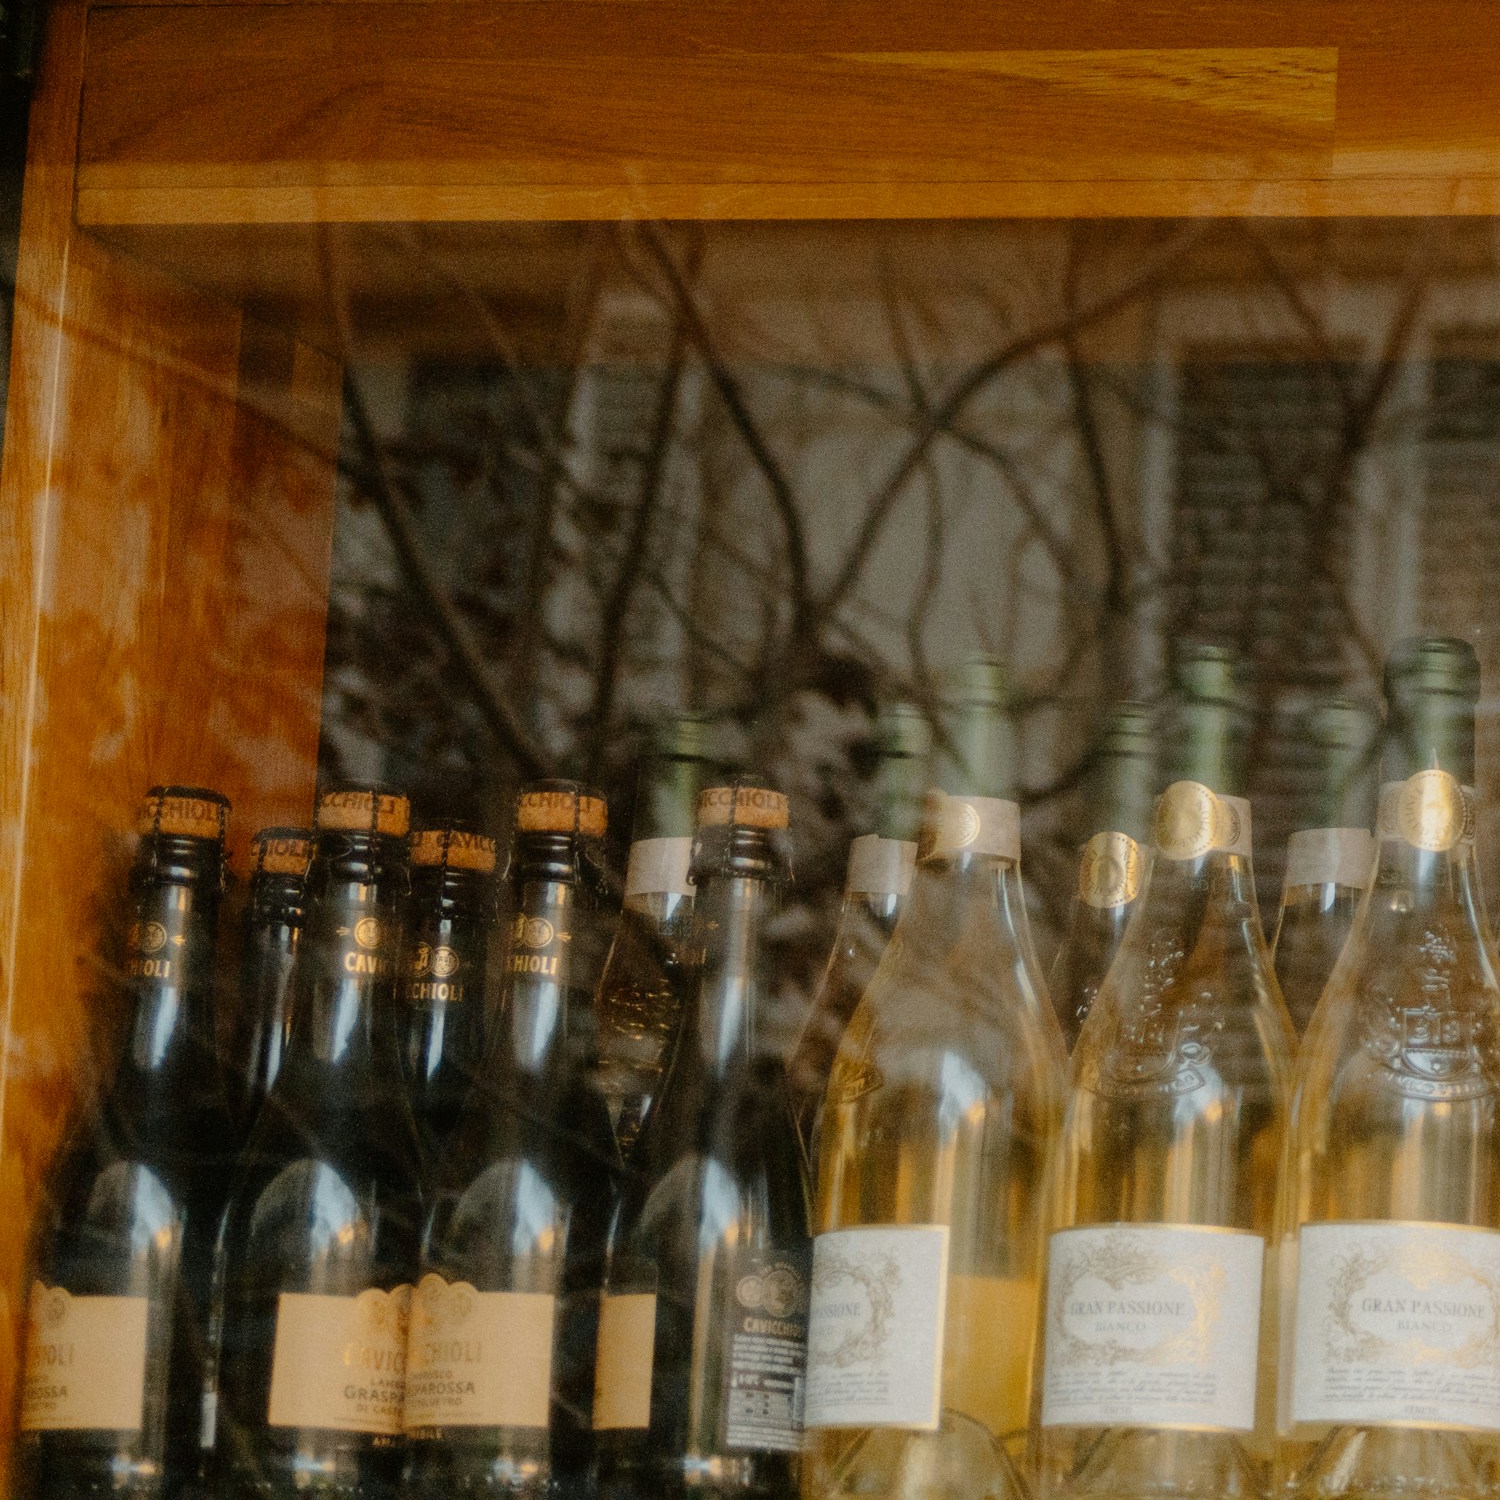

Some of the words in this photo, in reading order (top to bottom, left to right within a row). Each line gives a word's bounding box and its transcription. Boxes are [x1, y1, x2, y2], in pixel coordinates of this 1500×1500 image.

[1108, 1300, 1185, 1317] PASSIONE
[1361, 1299, 1406, 1315] GRAN
[1411, 1300, 1485, 1320] PASSIONE
